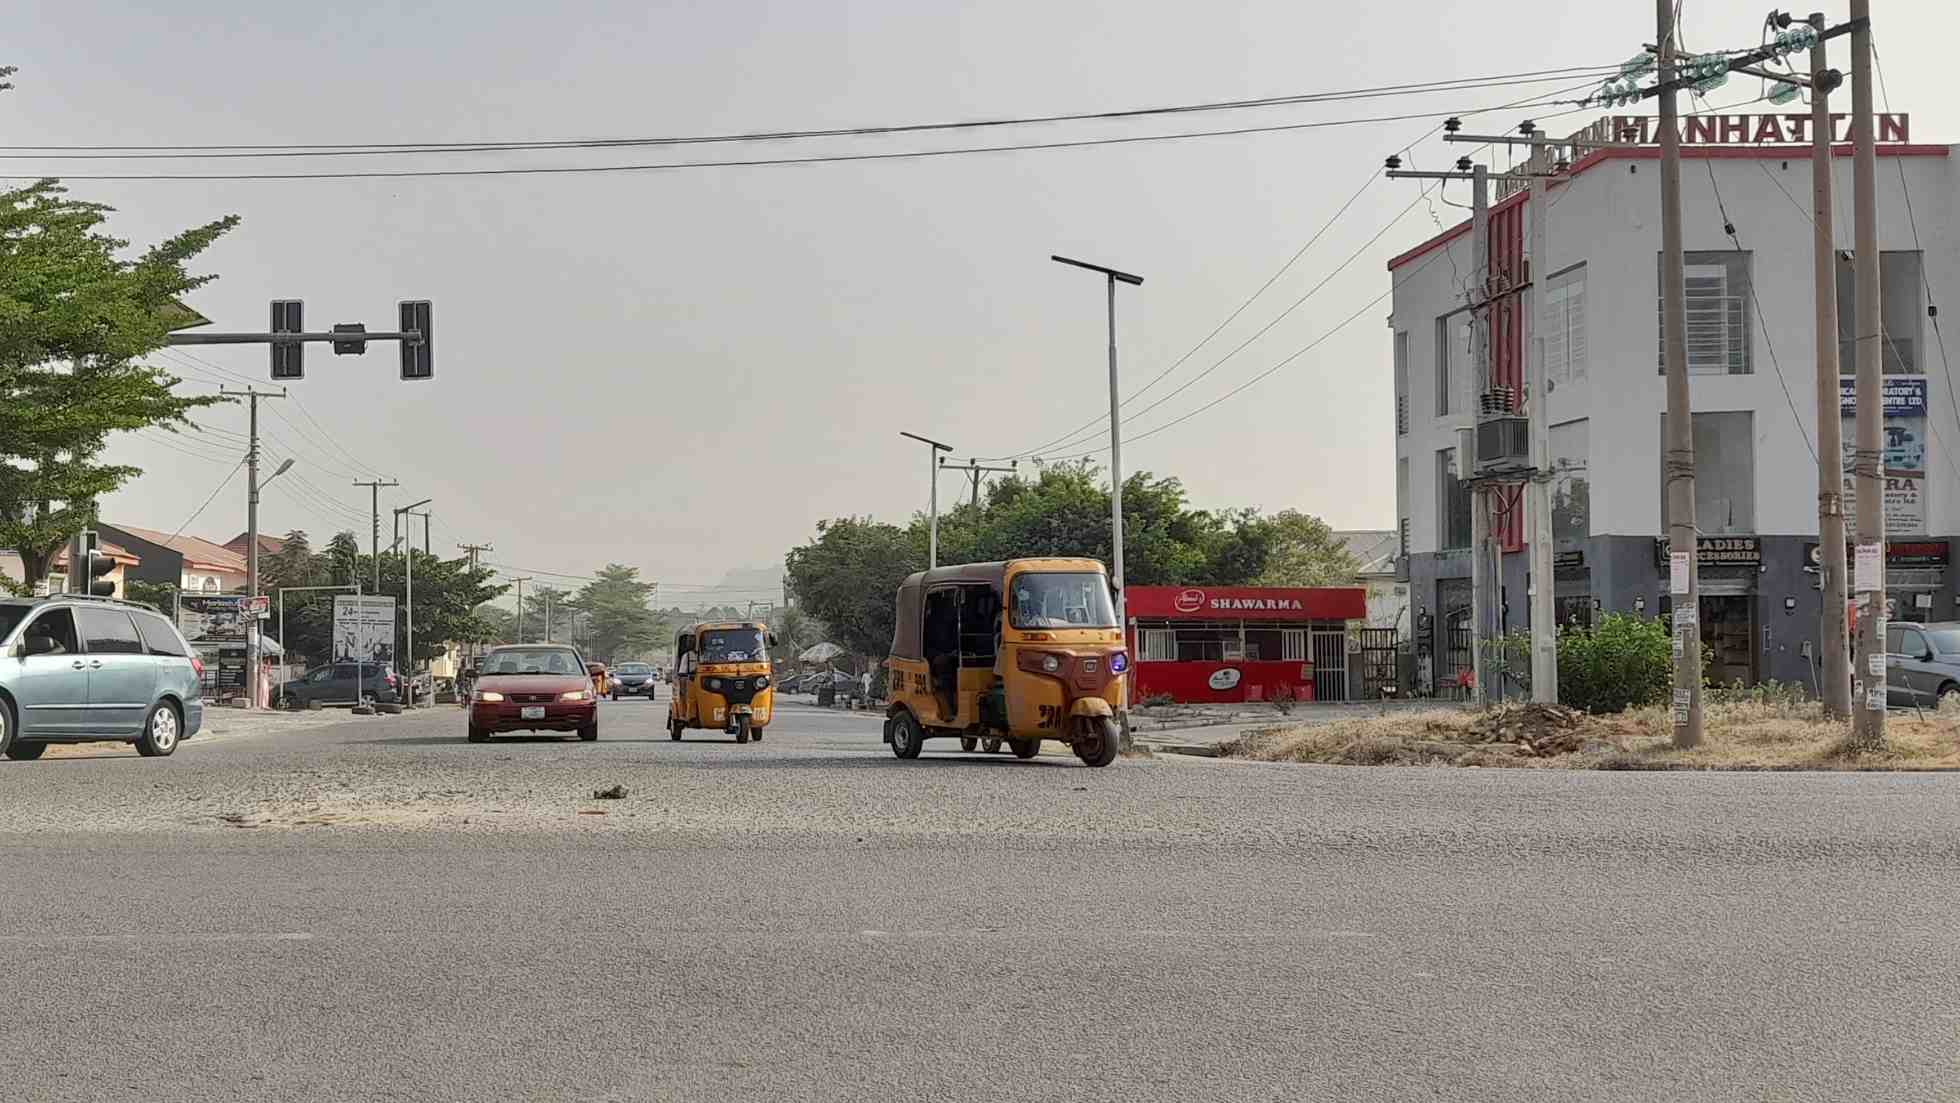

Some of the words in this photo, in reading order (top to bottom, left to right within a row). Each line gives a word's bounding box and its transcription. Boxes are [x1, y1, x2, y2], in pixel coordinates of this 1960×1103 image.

[1883, 396, 1905, 405] ENTRE
[1696, 551, 1760, 560] CESSORIES
[1210, 599, 1303, 609] SHAWARMA
